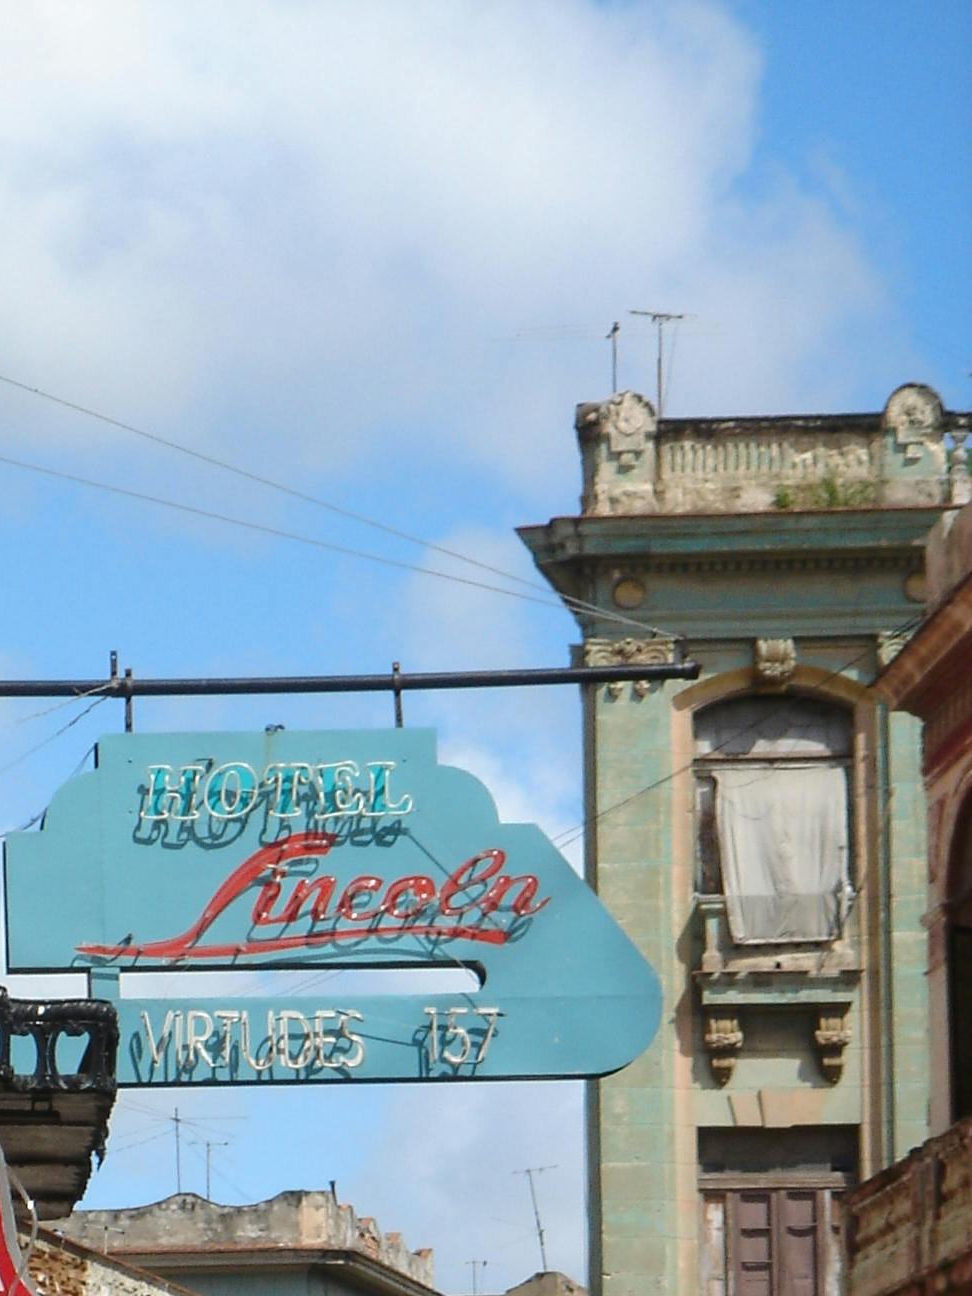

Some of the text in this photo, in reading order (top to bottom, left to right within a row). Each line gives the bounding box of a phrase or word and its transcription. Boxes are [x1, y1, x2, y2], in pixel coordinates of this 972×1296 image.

[138, 760, 414, 822] HOTEL
[74, 831, 551, 959] Lincoln
[140, 1006, 504, 1070] VIRTUDES 157
